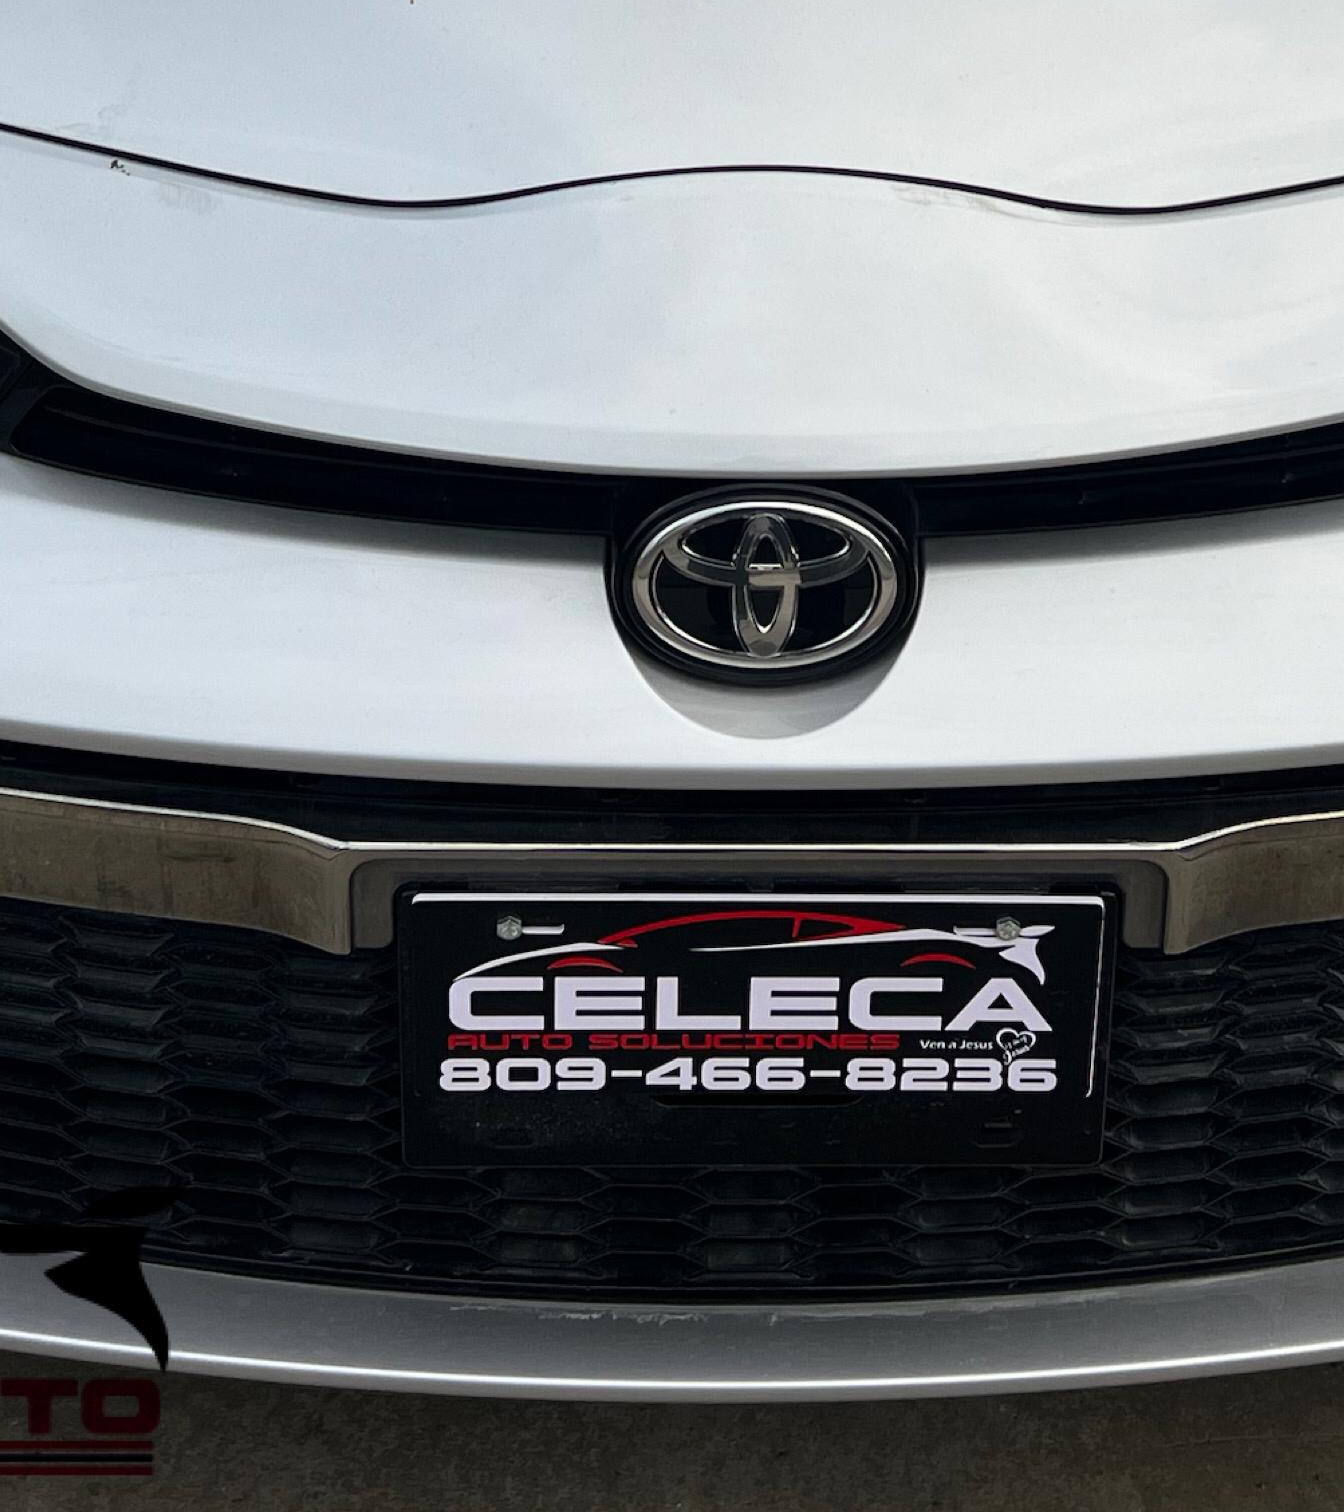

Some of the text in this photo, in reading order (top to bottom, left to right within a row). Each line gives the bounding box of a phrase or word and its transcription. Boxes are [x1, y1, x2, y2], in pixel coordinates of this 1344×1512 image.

[449, 976, 1053, 1031] CELECA
[448, 1034, 900, 1051] AUTO SOLUCIONES
[919, 1039, 993, 1050] Ven a Jesus
[439, 1057, 1057, 1092] 809-466-8236
